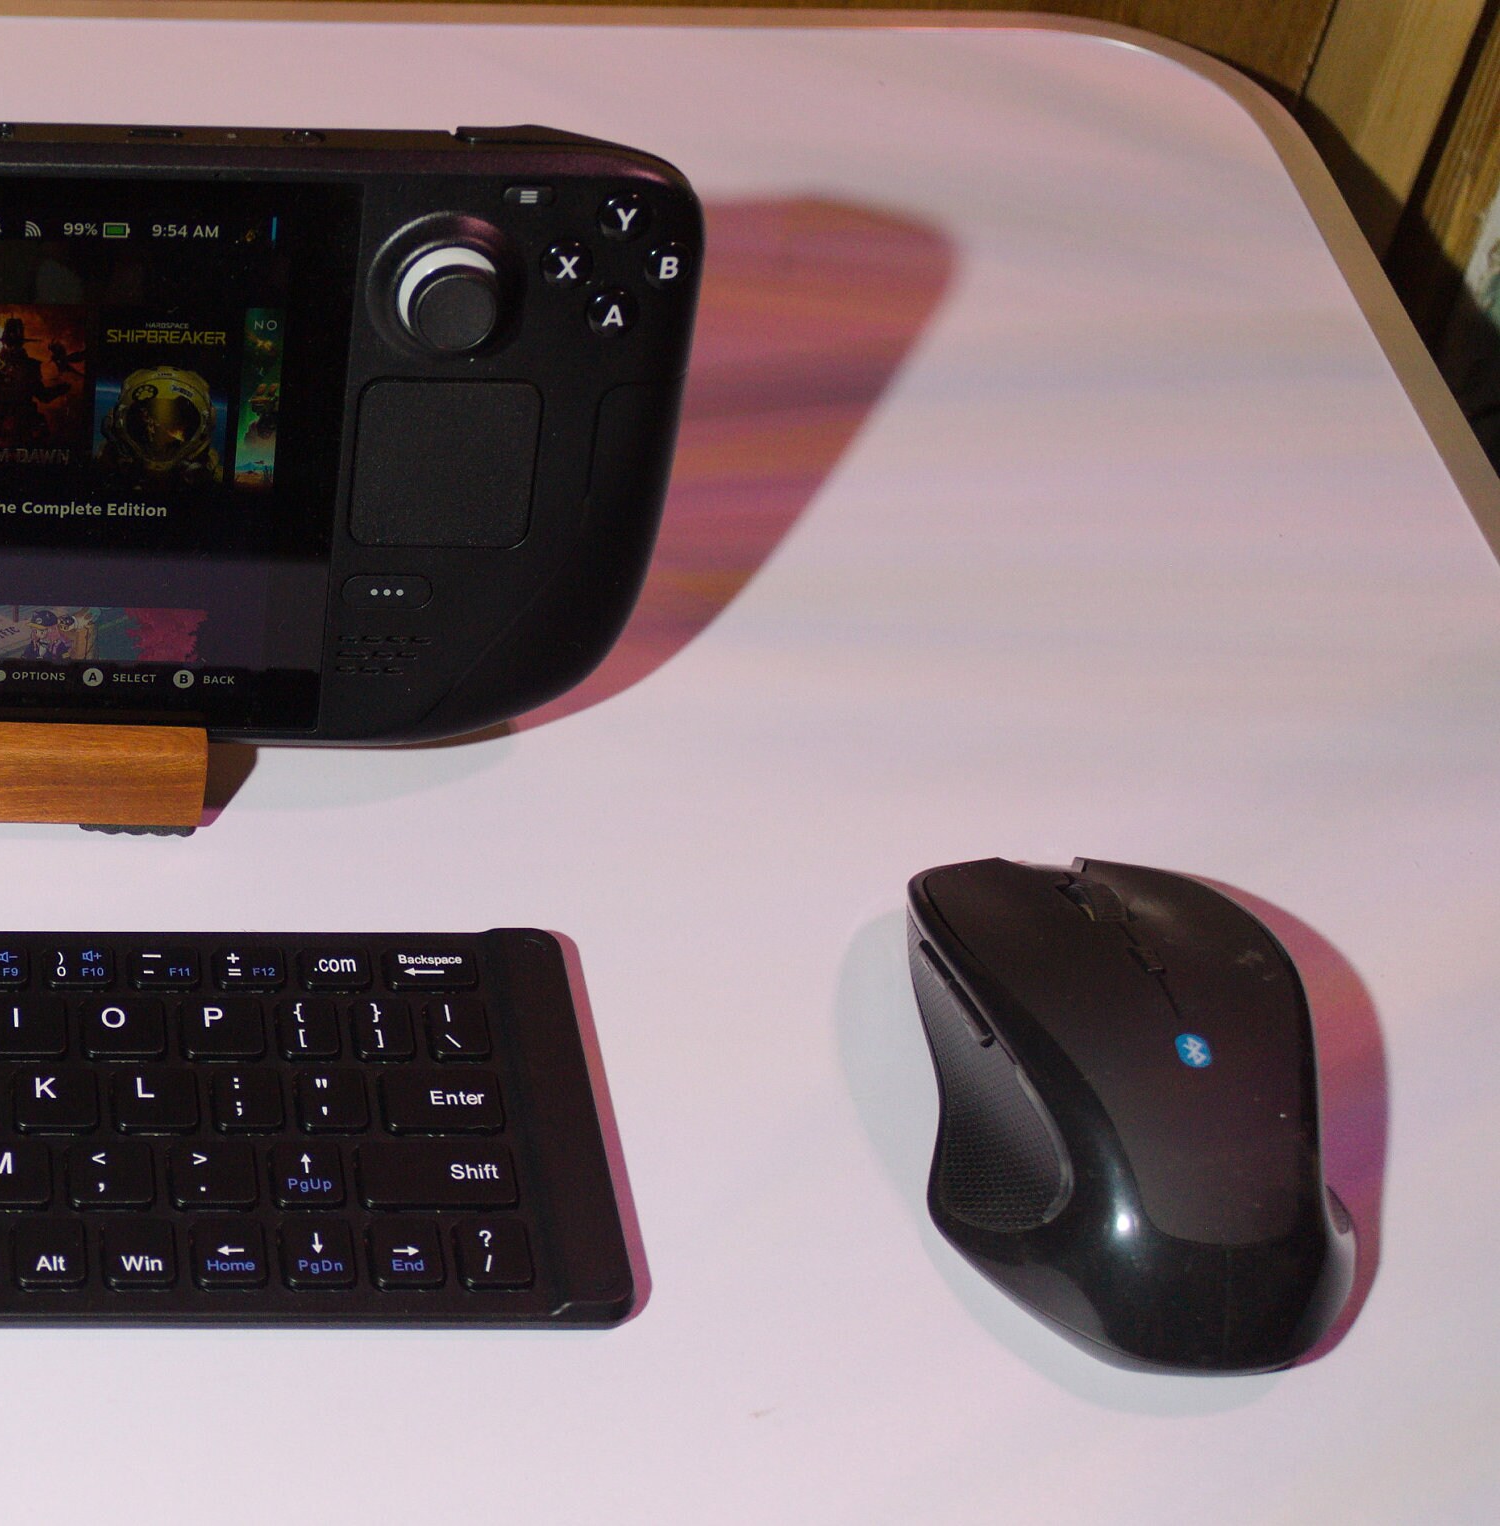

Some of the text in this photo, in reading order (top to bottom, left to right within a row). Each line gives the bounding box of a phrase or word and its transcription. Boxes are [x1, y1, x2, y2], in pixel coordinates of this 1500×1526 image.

[616, 208, 638, 231] Y
[63, 222, 98, 236] 99%
[152, 224, 219, 239] 9:54 AM
[556, 256, 579, 279] X
[659, 256, 679, 279] B
[601, 304, 624, 327] A
[106, 329, 227, 345] SHIPBREAKER
[15, 448, 71, 465] DAWN
[21, 501, 102, 518] Complete
[107, 503, 168, 517] Edition
[11, 670, 66, 682] OPTIONS
[112, 672, 156, 684] SELECT
[202, 674, 235, 685] BACK
[314, 959, 356, 972] .com
[398, 954, 462, 966] Backspace
[3, 968, 18, 976] F9
[82, 968, 103, 976] F10
[169, 968, 189, 976] F11
[253, 968, 275, 976] F12
[14, 1008, 18, 1027] I
[102, 1008, 125, 1028] O
[204, 1008, 223, 1027] P
[294, 1003, 304, 1022] {
[370, 1003, 381, 1022] }
[299, 1029, 307, 1047] [
[375, 1030, 384, 1048] ]
[36, 1078, 56, 1098] K
[137, 1078, 154, 1098] L
[430, 1091, 484, 1105] Enter
[451, 1164, 499, 1179] Shift
[288, 1178, 332, 1192] PgUp
[479, 1230, 491, 1247] ?
[37, 1256, 65, 1271] Alt
[122, 1256, 162, 1271] Win
[207, 1260, 255, 1271] Home
[299, 1260, 343, 1274] PgDn
[392, 1259, 424, 1271] End
[486, 1255, 492, 1272] /
